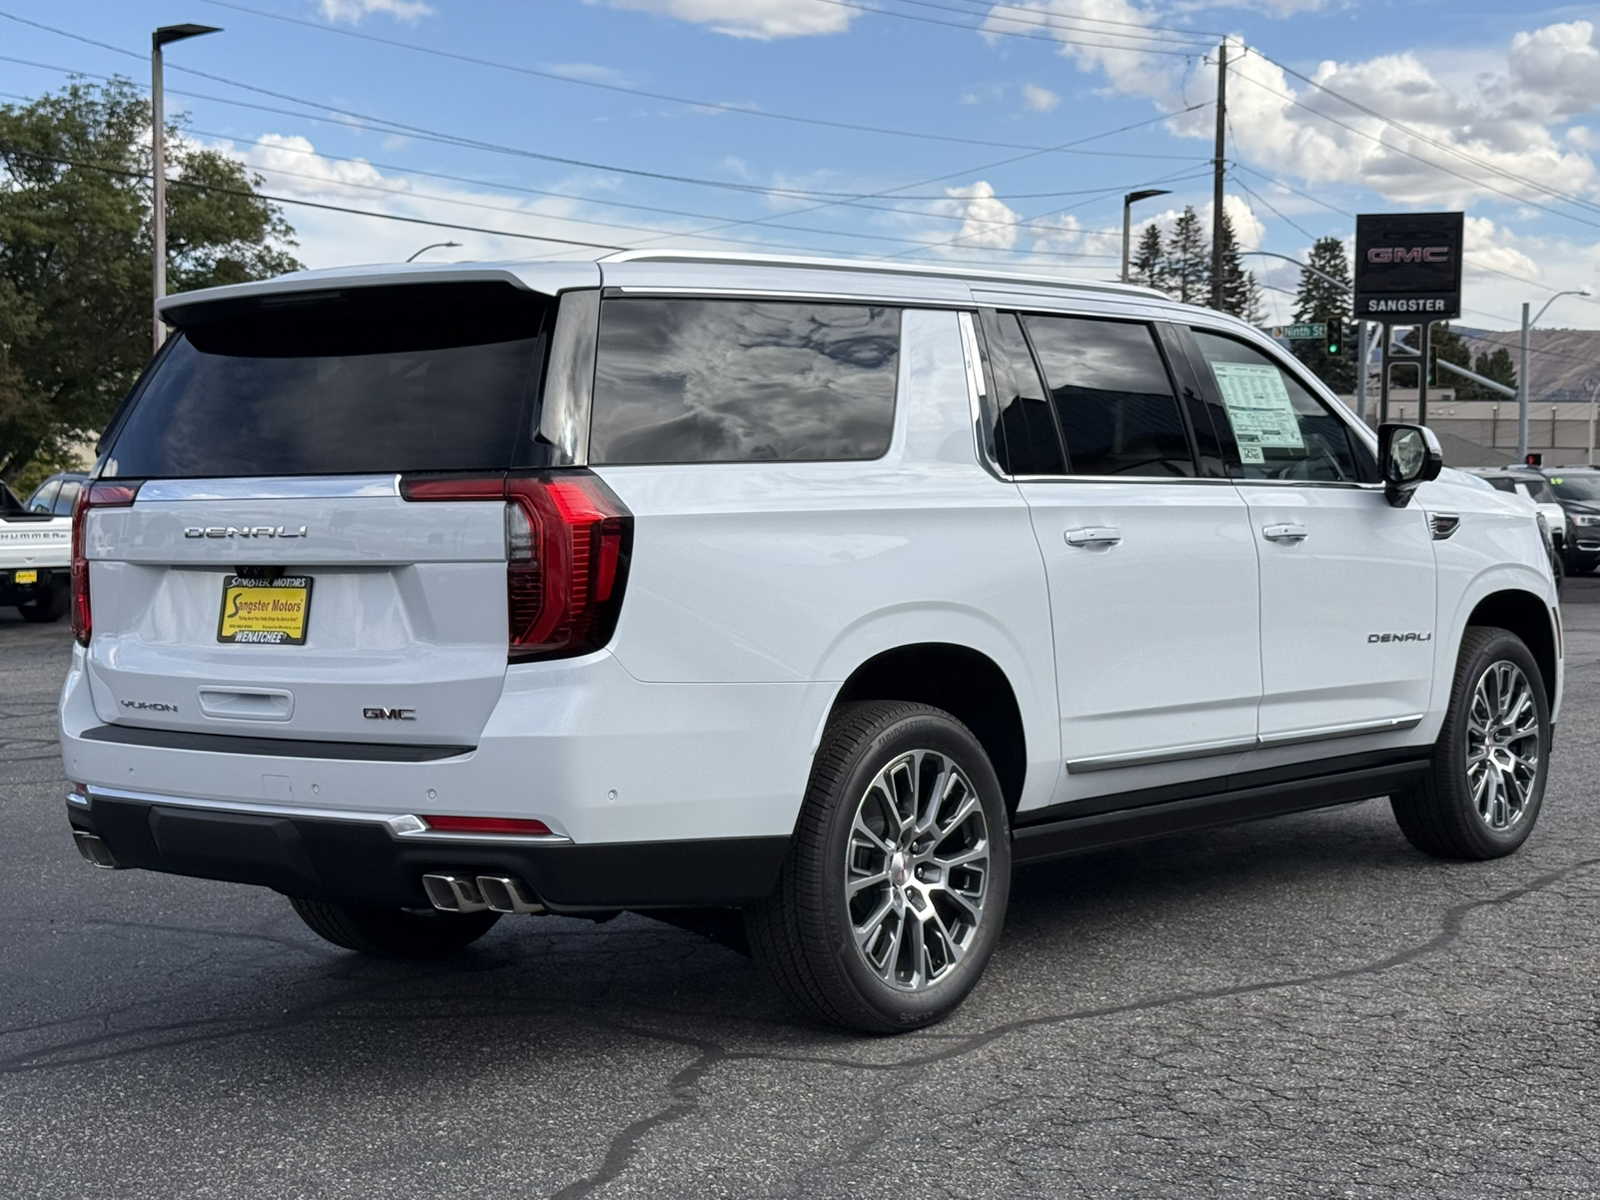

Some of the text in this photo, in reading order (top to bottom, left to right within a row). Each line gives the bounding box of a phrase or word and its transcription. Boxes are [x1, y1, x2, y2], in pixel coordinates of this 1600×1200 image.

[1367, 246, 1449, 264] GMC
[1368, 299, 1445, 312] SANGSTER
[1284, 325, 1324, 337] Ninth St
[184, 525, 308, 539] DENALI
[227, 576, 306, 589] SANGSTER MOTORS
[227, 592, 301, 619] Sangster Motors
[235, 630, 282, 643] WENATCHEE
[1367, 631, 1431, 643] DENALI
[120, 699, 178, 713] YUKON
[363, 707, 416, 721] GMC
